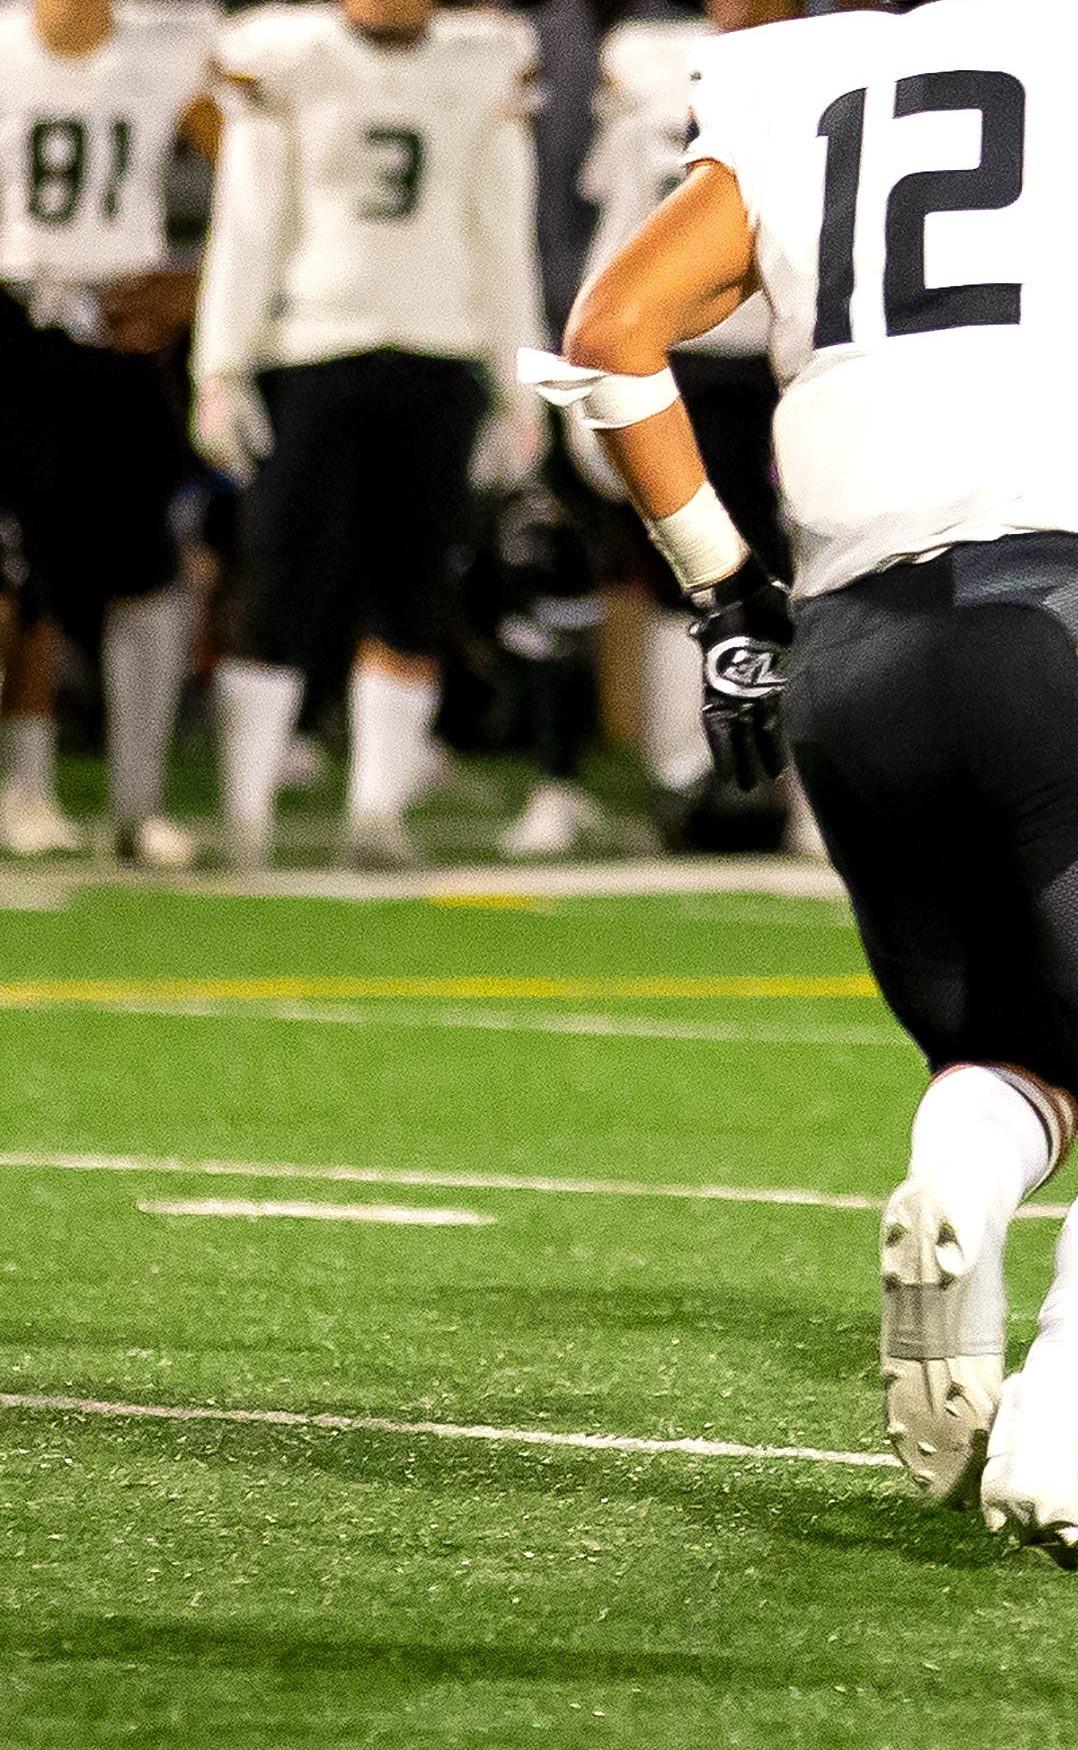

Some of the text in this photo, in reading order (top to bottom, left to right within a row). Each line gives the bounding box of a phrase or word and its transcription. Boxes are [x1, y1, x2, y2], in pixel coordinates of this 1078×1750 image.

[28, 118, 132, 225] 81
[358, 122, 426, 222] 3
[813, 70, 1025, 349] 12
